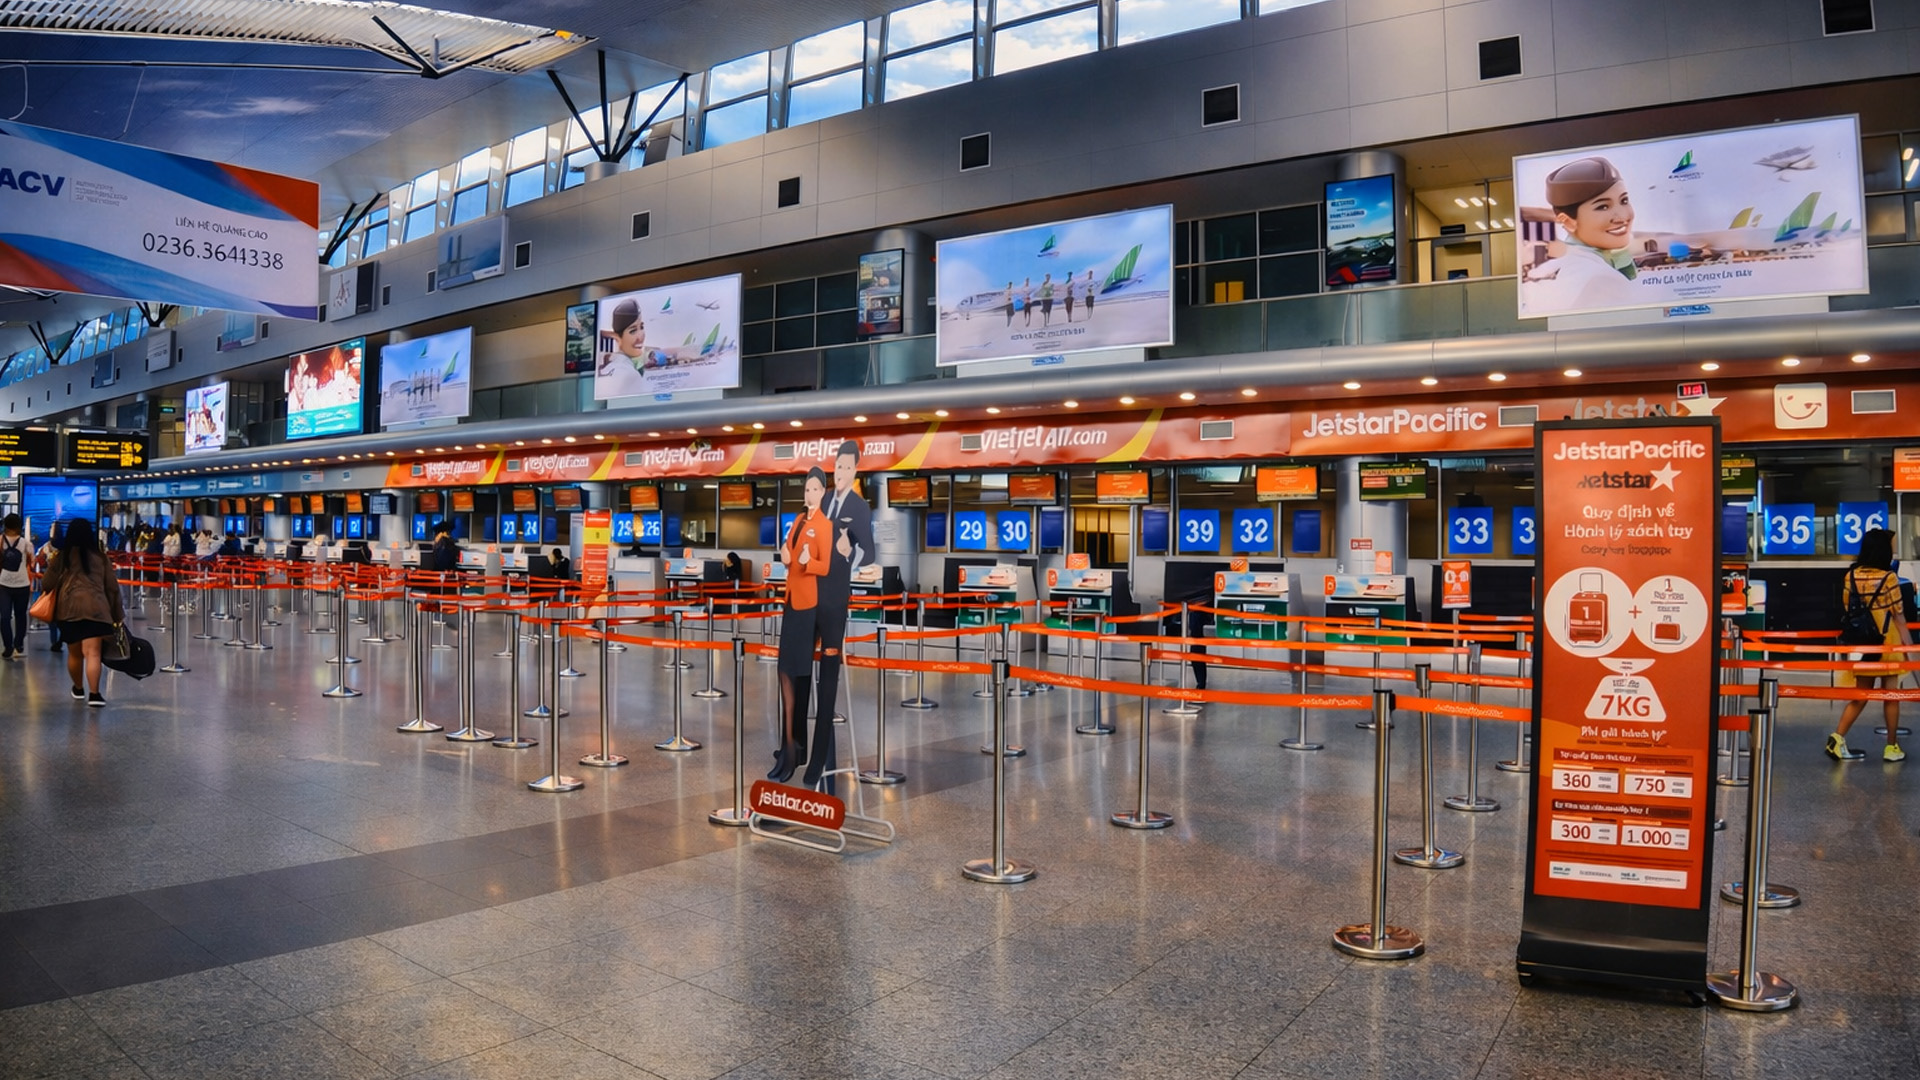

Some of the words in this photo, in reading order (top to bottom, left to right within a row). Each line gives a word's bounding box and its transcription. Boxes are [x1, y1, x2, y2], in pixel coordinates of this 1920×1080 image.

[0, 168, 65, 196] ACV
[1302, 407, 1488, 438] JetstarPacific
[1553, 440, 1706, 461] JetstarPacific
[960, 520, 984, 541] 29
[1002, 520, 1028, 542] 30
[1240, 518, 1269, 543] 32
[1454, 517, 1489, 544] 33
[1519, 517, 1536, 544] 3
[1770, 515, 1811, 544] 35
[1582, 606, 1590, 619] 1
[1601, 694, 1652, 717] 7KG
[1562, 773, 1591, 788] 360
[1634, 777, 1666, 793] 750
[1561, 824, 1591, 840] 300
[1627, 829, 1672, 846] 1.000
